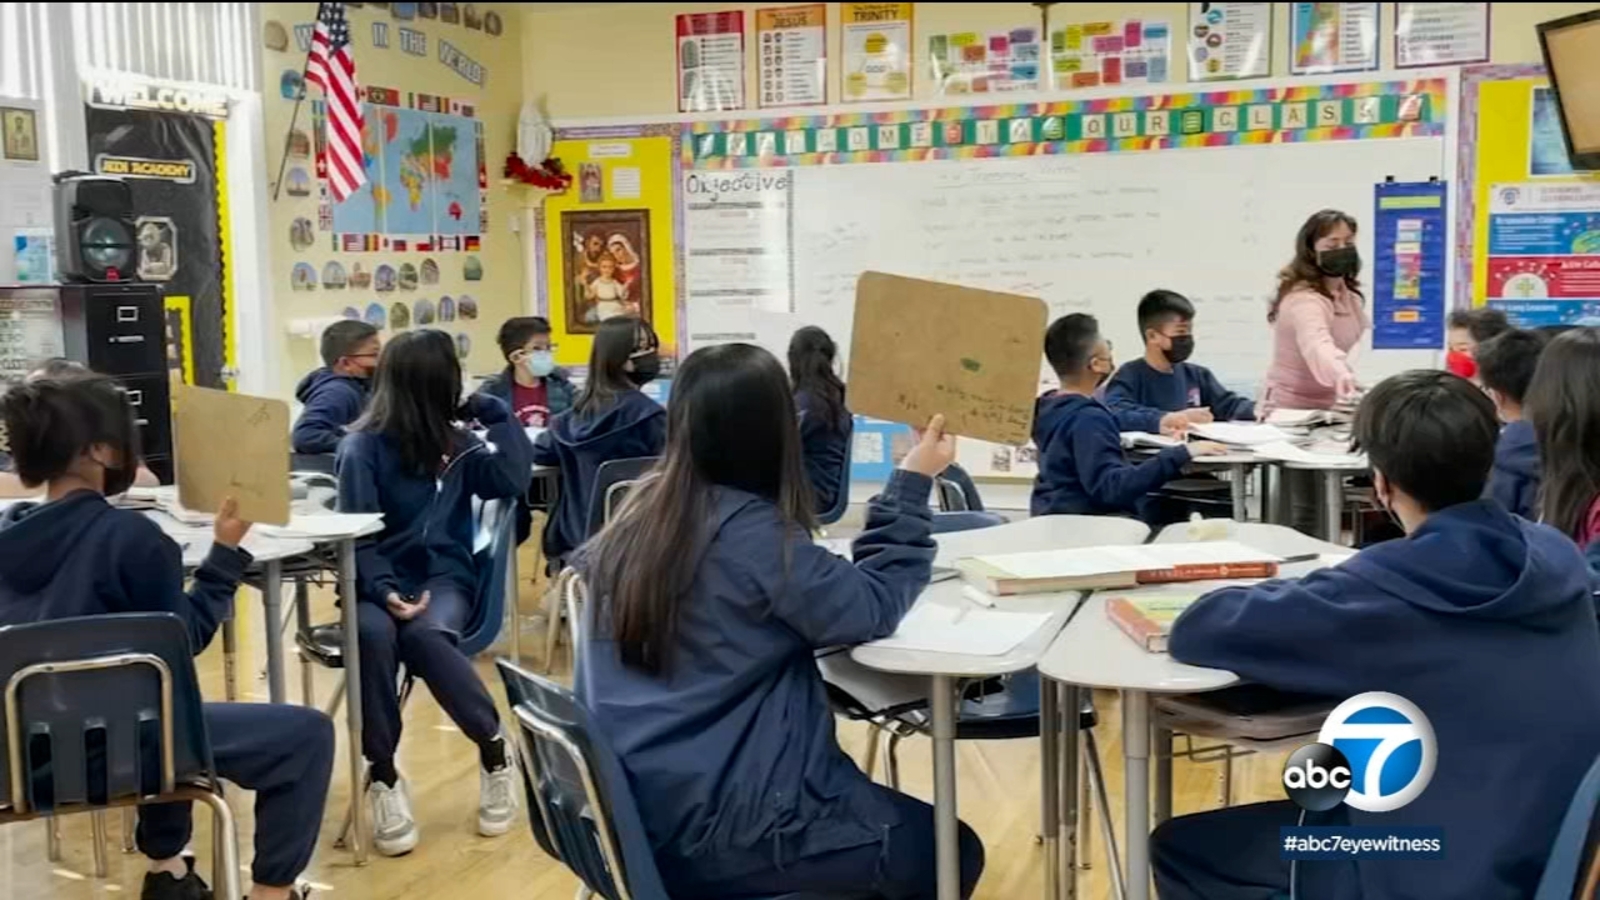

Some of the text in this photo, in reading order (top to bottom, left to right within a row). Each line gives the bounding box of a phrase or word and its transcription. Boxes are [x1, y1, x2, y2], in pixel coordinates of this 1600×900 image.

[773, 16, 807, 28] JESUS
[853, 9, 899, 21] TRINITY
[371, 22, 389, 48] IN
[398, 28, 427, 56] THE
[93, 80, 228, 117] WELCOME
[1085, 114, 1166, 135] OUR
[1218, 101, 1376, 128] CLASS
[103, 159, 189, 177] JEDI ACADEMY
[686, 173, 786, 201] Objective
